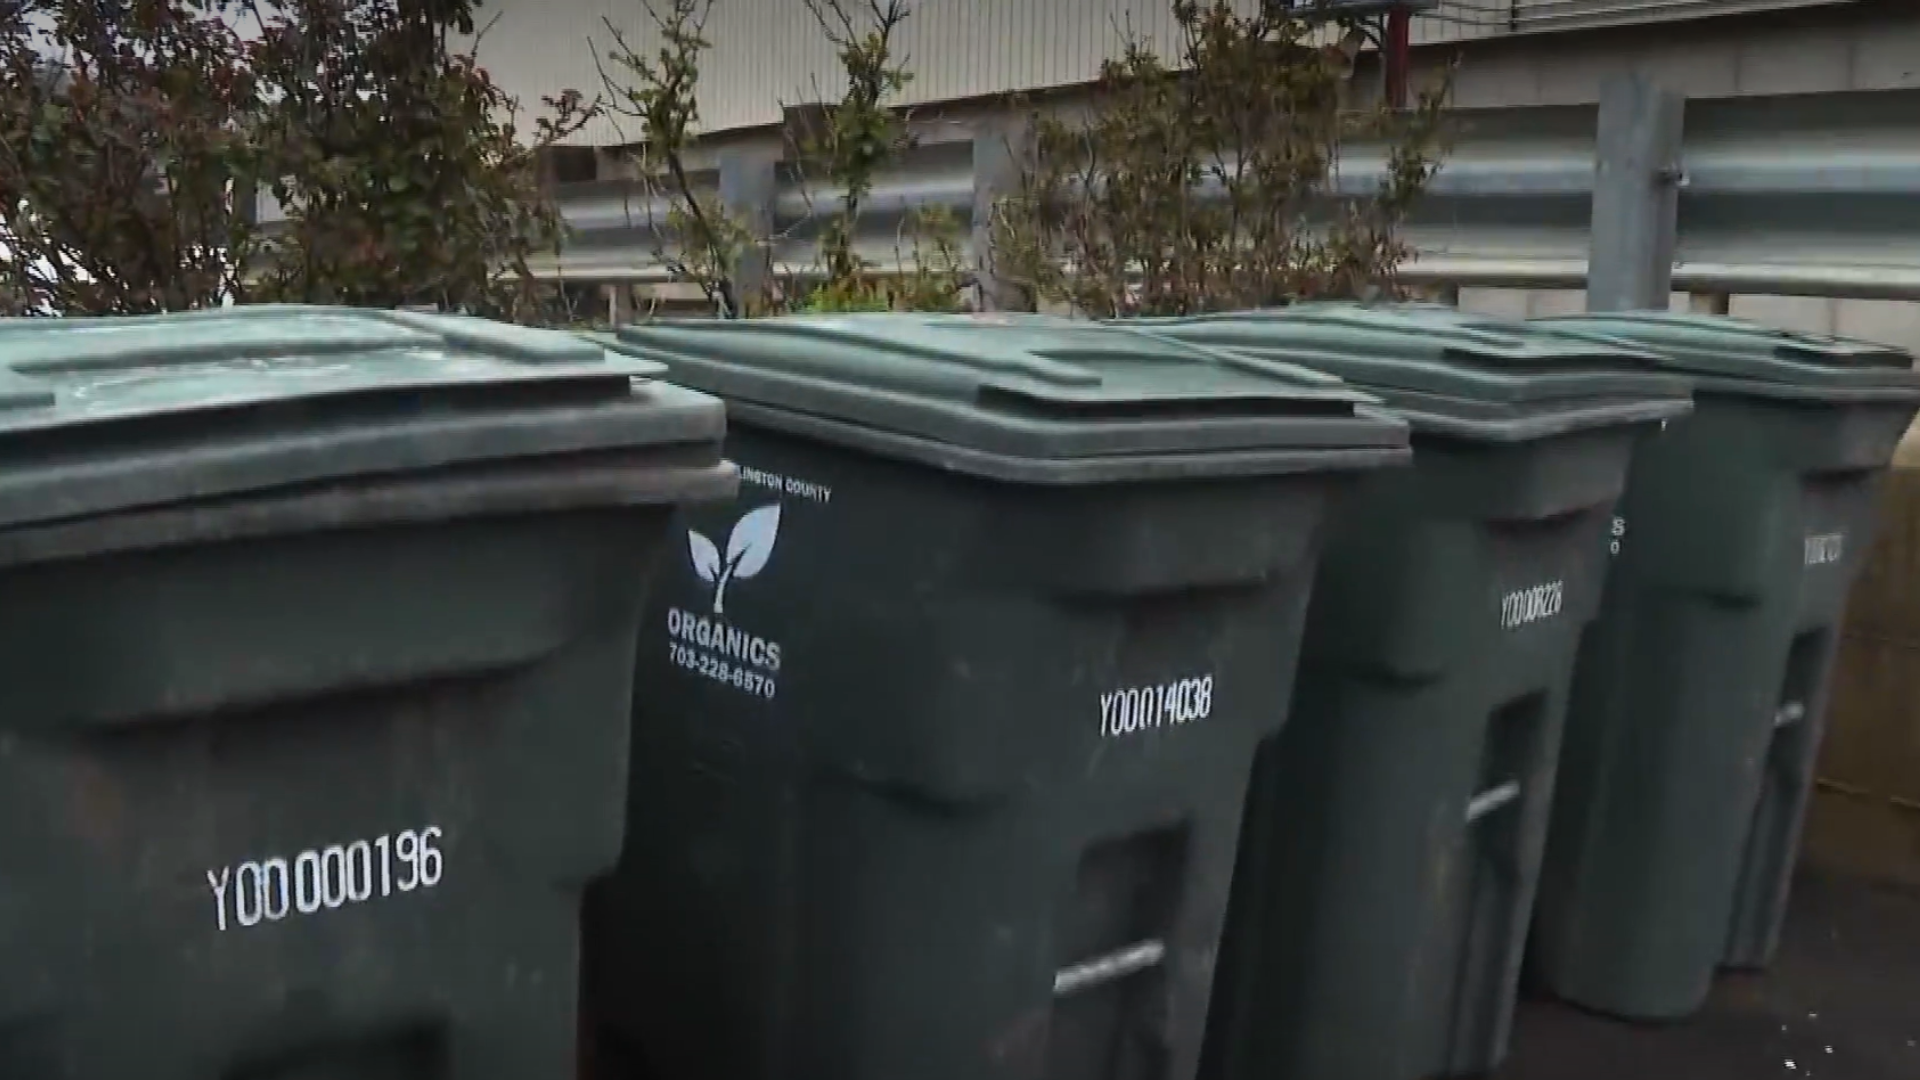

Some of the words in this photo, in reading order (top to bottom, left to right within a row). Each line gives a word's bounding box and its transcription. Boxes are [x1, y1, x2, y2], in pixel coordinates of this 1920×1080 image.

[667, 607, 781, 671] ORGANICS
[669, 641, 776, 699] 703-228-6570
[1100, 675, 1213, 737] Y00014038
